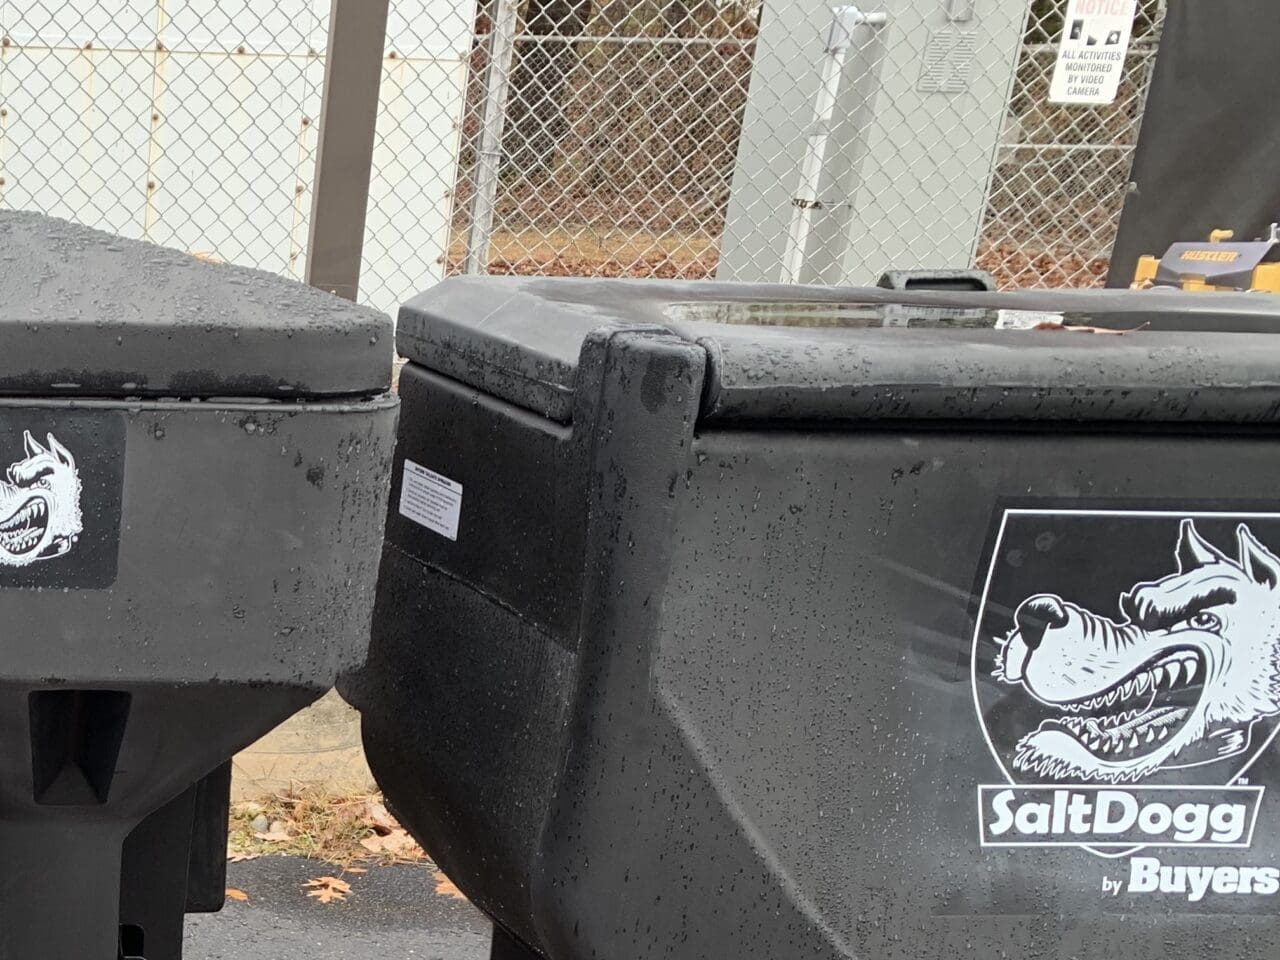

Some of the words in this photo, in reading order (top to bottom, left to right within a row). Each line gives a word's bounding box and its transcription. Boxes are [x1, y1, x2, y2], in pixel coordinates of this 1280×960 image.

[1074, 0, 1129, 16] NOTICE
[1062, 50, 1076, 60] ALL
[1078, 51, 1122, 61] ACTIVITIES
[1065, 62, 1113, 73] MONITORED
[1067, 74, 1079, 84] BY
[1080, 75, 1105, 84] VIDEO
[1066, 87, 1100, 96] CAMERA
[988, 789, 1247, 842] SaltDogg
[1102, 875, 1122, 894] by
[1128, 857, 1280, 901] Buyers
